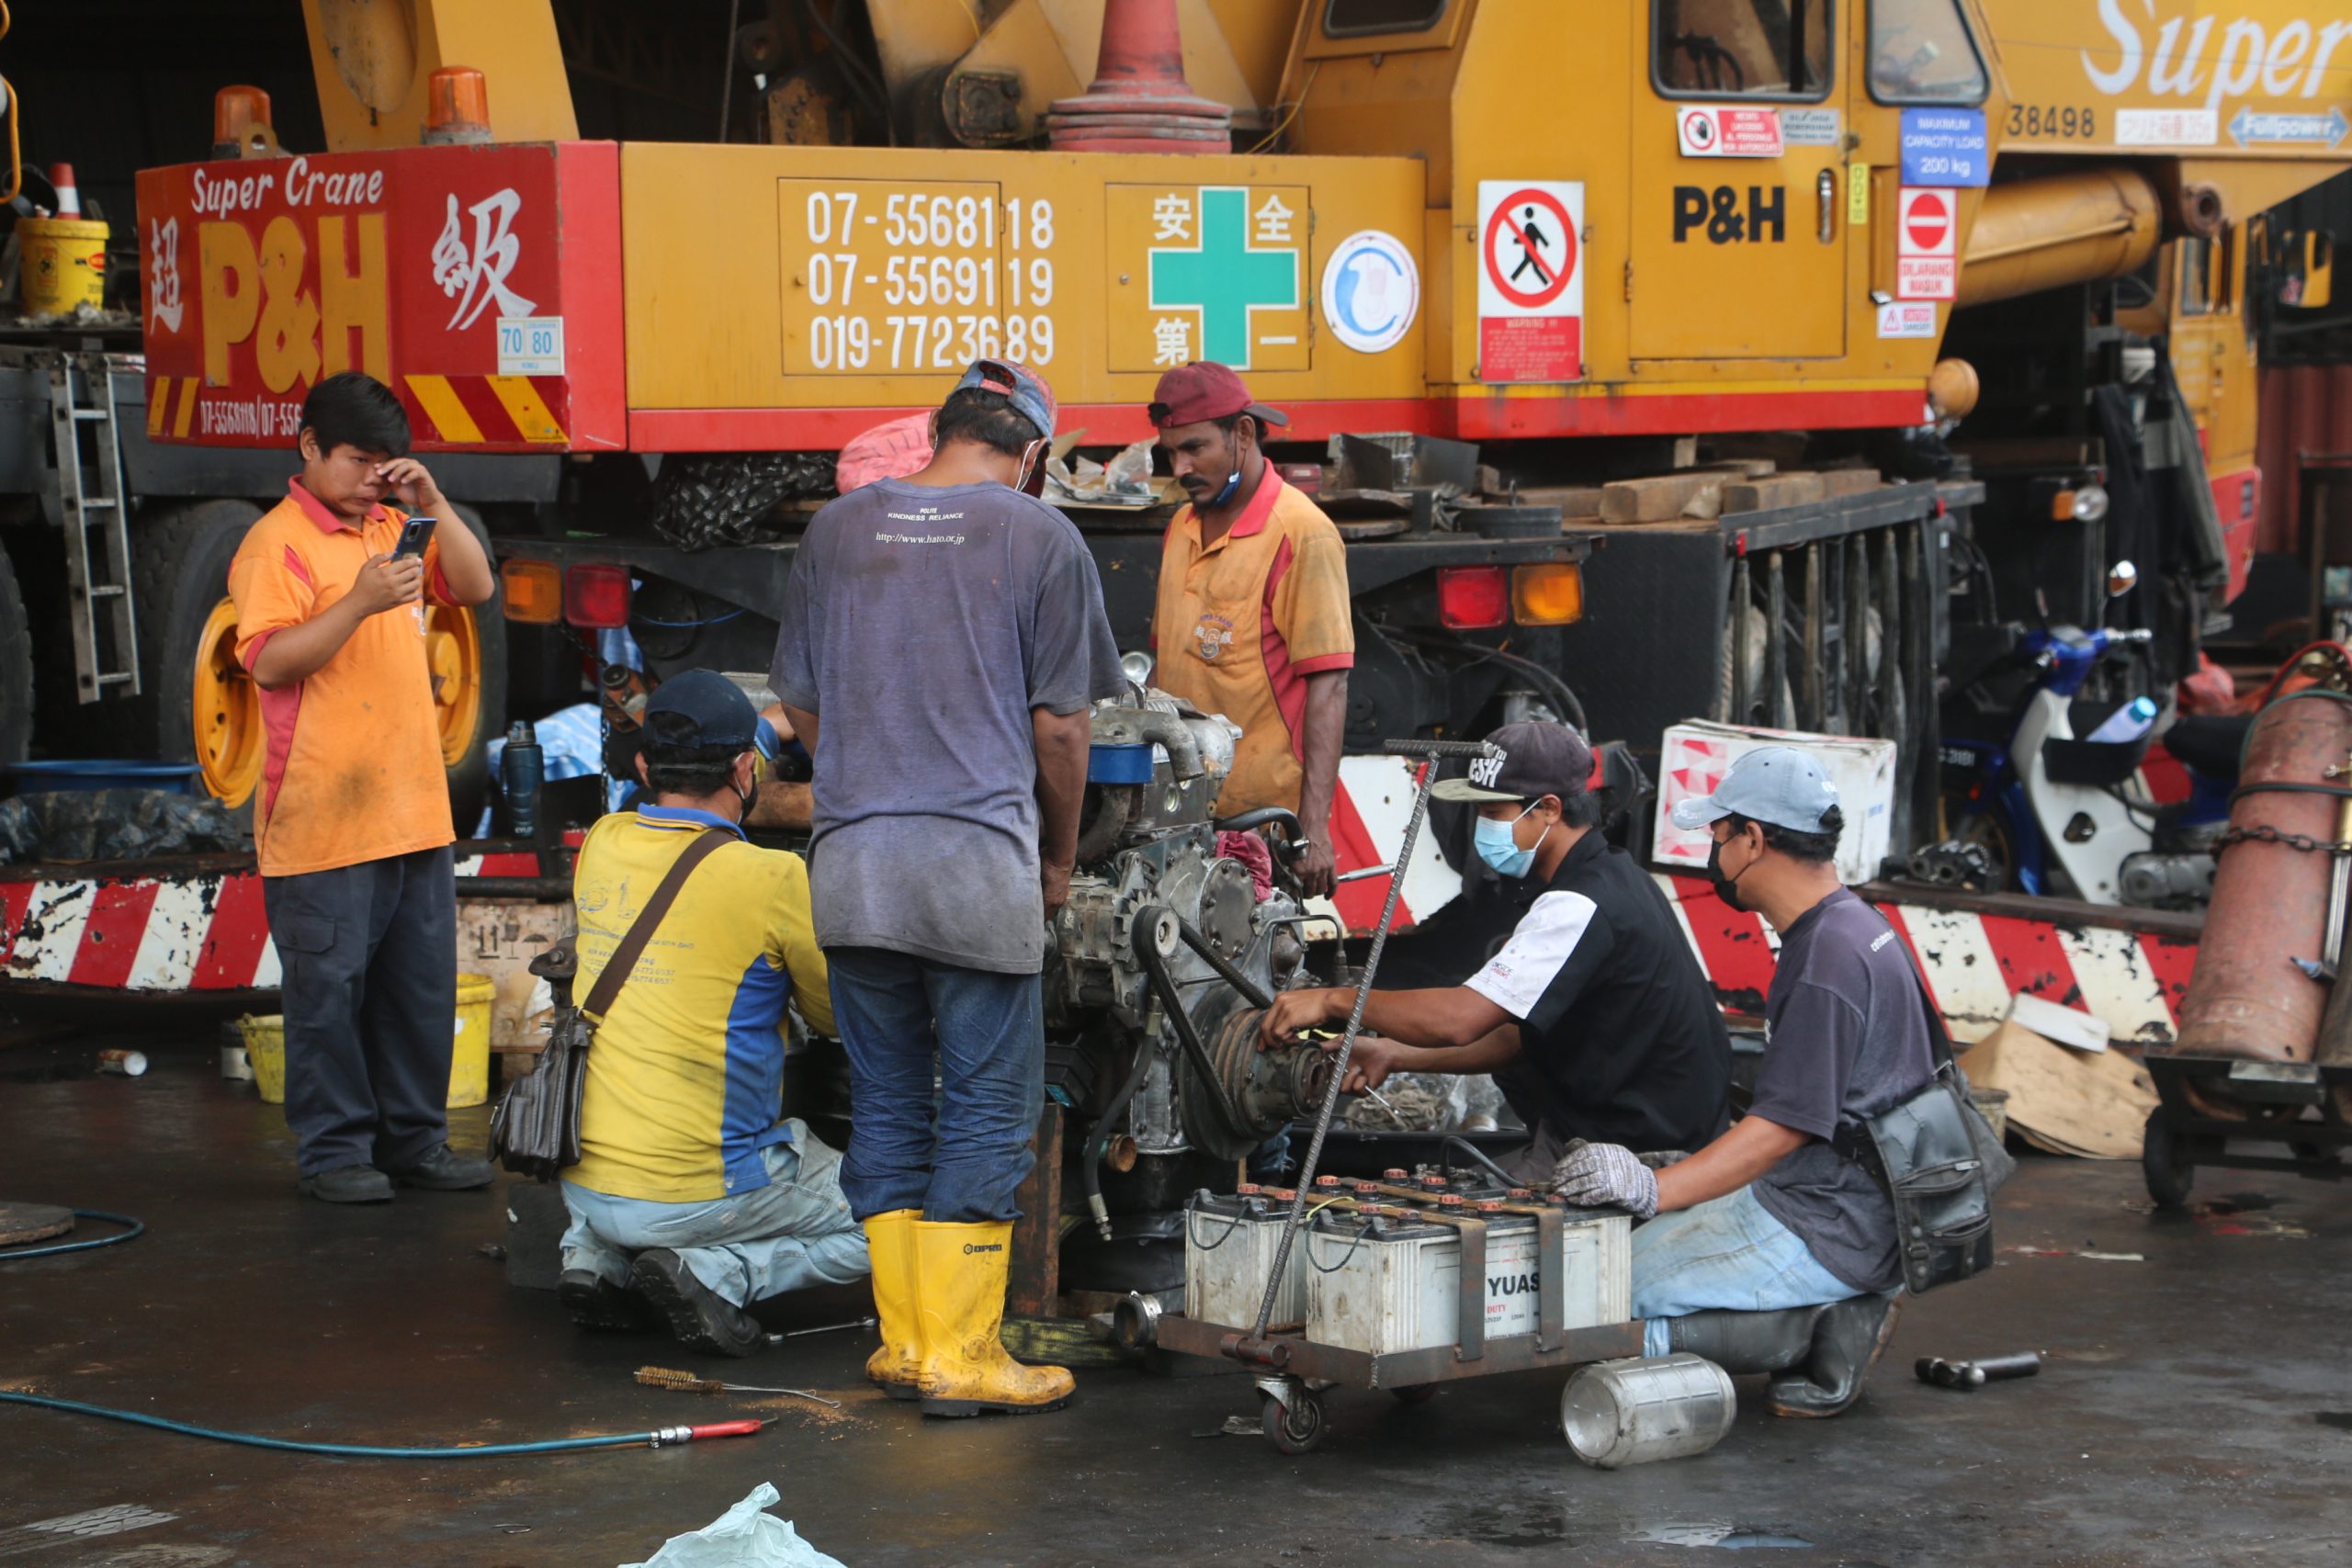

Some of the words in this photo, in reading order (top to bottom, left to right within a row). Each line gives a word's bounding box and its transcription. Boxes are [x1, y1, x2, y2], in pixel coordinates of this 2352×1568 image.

[2079, 0, 2352, 112] Super
[1917, 118, 1971, 130] MAXIMUM
[2006, 104, 2096, 138] 38498
[1904, 135, 1954, 149] CAPACITY
[1956, 136, 1984, 150] LOAD
[1920, 157, 1949, 175] 200
[1951, 159, 1971, 177] kg
[191, 167, 274, 220] Super
[285, 156, 384, 207] Crane
[1152, 193, 1193, 241] 安
[1254, 194, 1295, 242] 全
[1672, 186, 1786, 244] P&H
[198, 212, 393, 394] P&H
[502, 328, 522, 354] 70
[532, 332, 552, 354] 80
[1153, 317, 1192, 366] 第
[200, 394, 303, 440] 07-5568118/07-556
[888, 513, 926, 522] KINDNESS
[928, 513, 965, 522] RELIANCE
[876, 532, 965, 545] http://www.hato.or.jp
[1487, 1271, 1540, 1297] YUAS
[1487, 1304, 1507, 1314] DUTY
